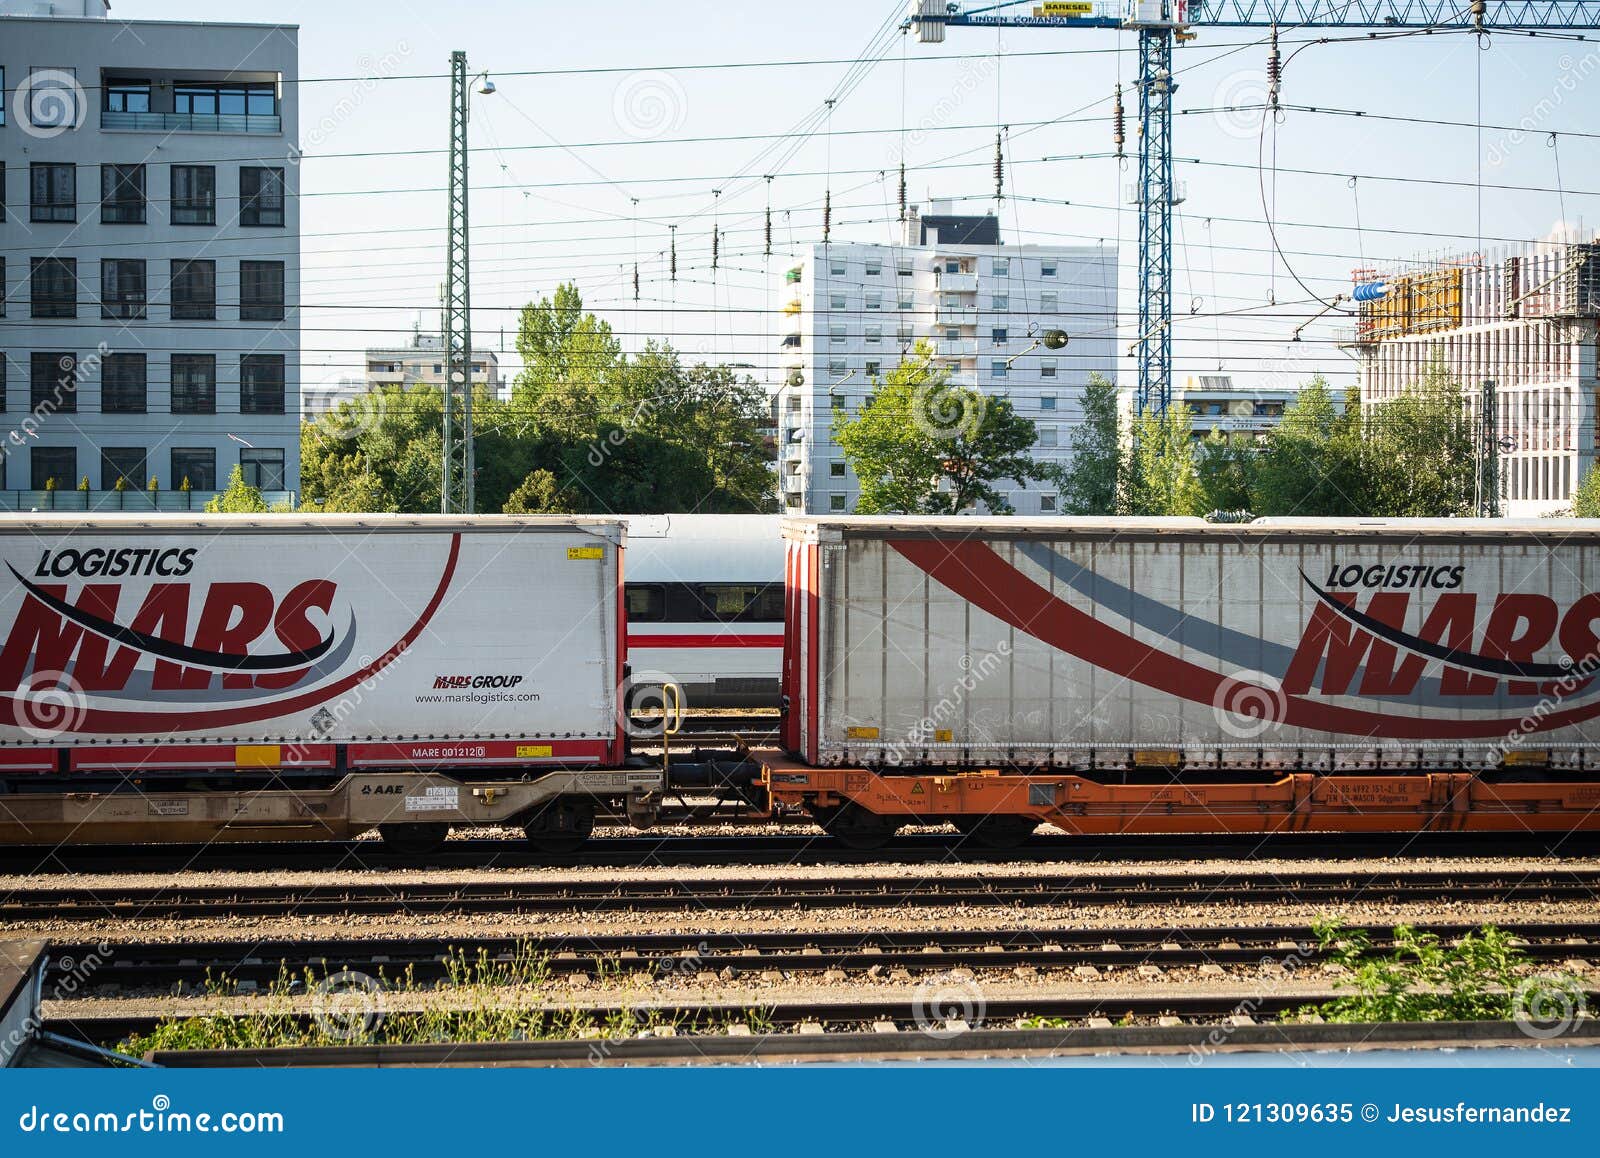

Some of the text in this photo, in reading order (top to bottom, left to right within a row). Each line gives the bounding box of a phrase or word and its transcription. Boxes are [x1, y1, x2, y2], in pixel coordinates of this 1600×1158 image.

[1013, 16, 1067, 24] COMANSA
[35, 548, 199, 577] LOGISTICS
[1326, 564, 1466, 589] LOGISTICS
[0, 579, 338, 691] MARS
[432, 675, 523, 689] MARS GROUP
[415, 692, 540, 705] www.marslogistics.com
[412, 747, 485, 757] MARE 0012120
[374, 784, 404, 794] AAE
